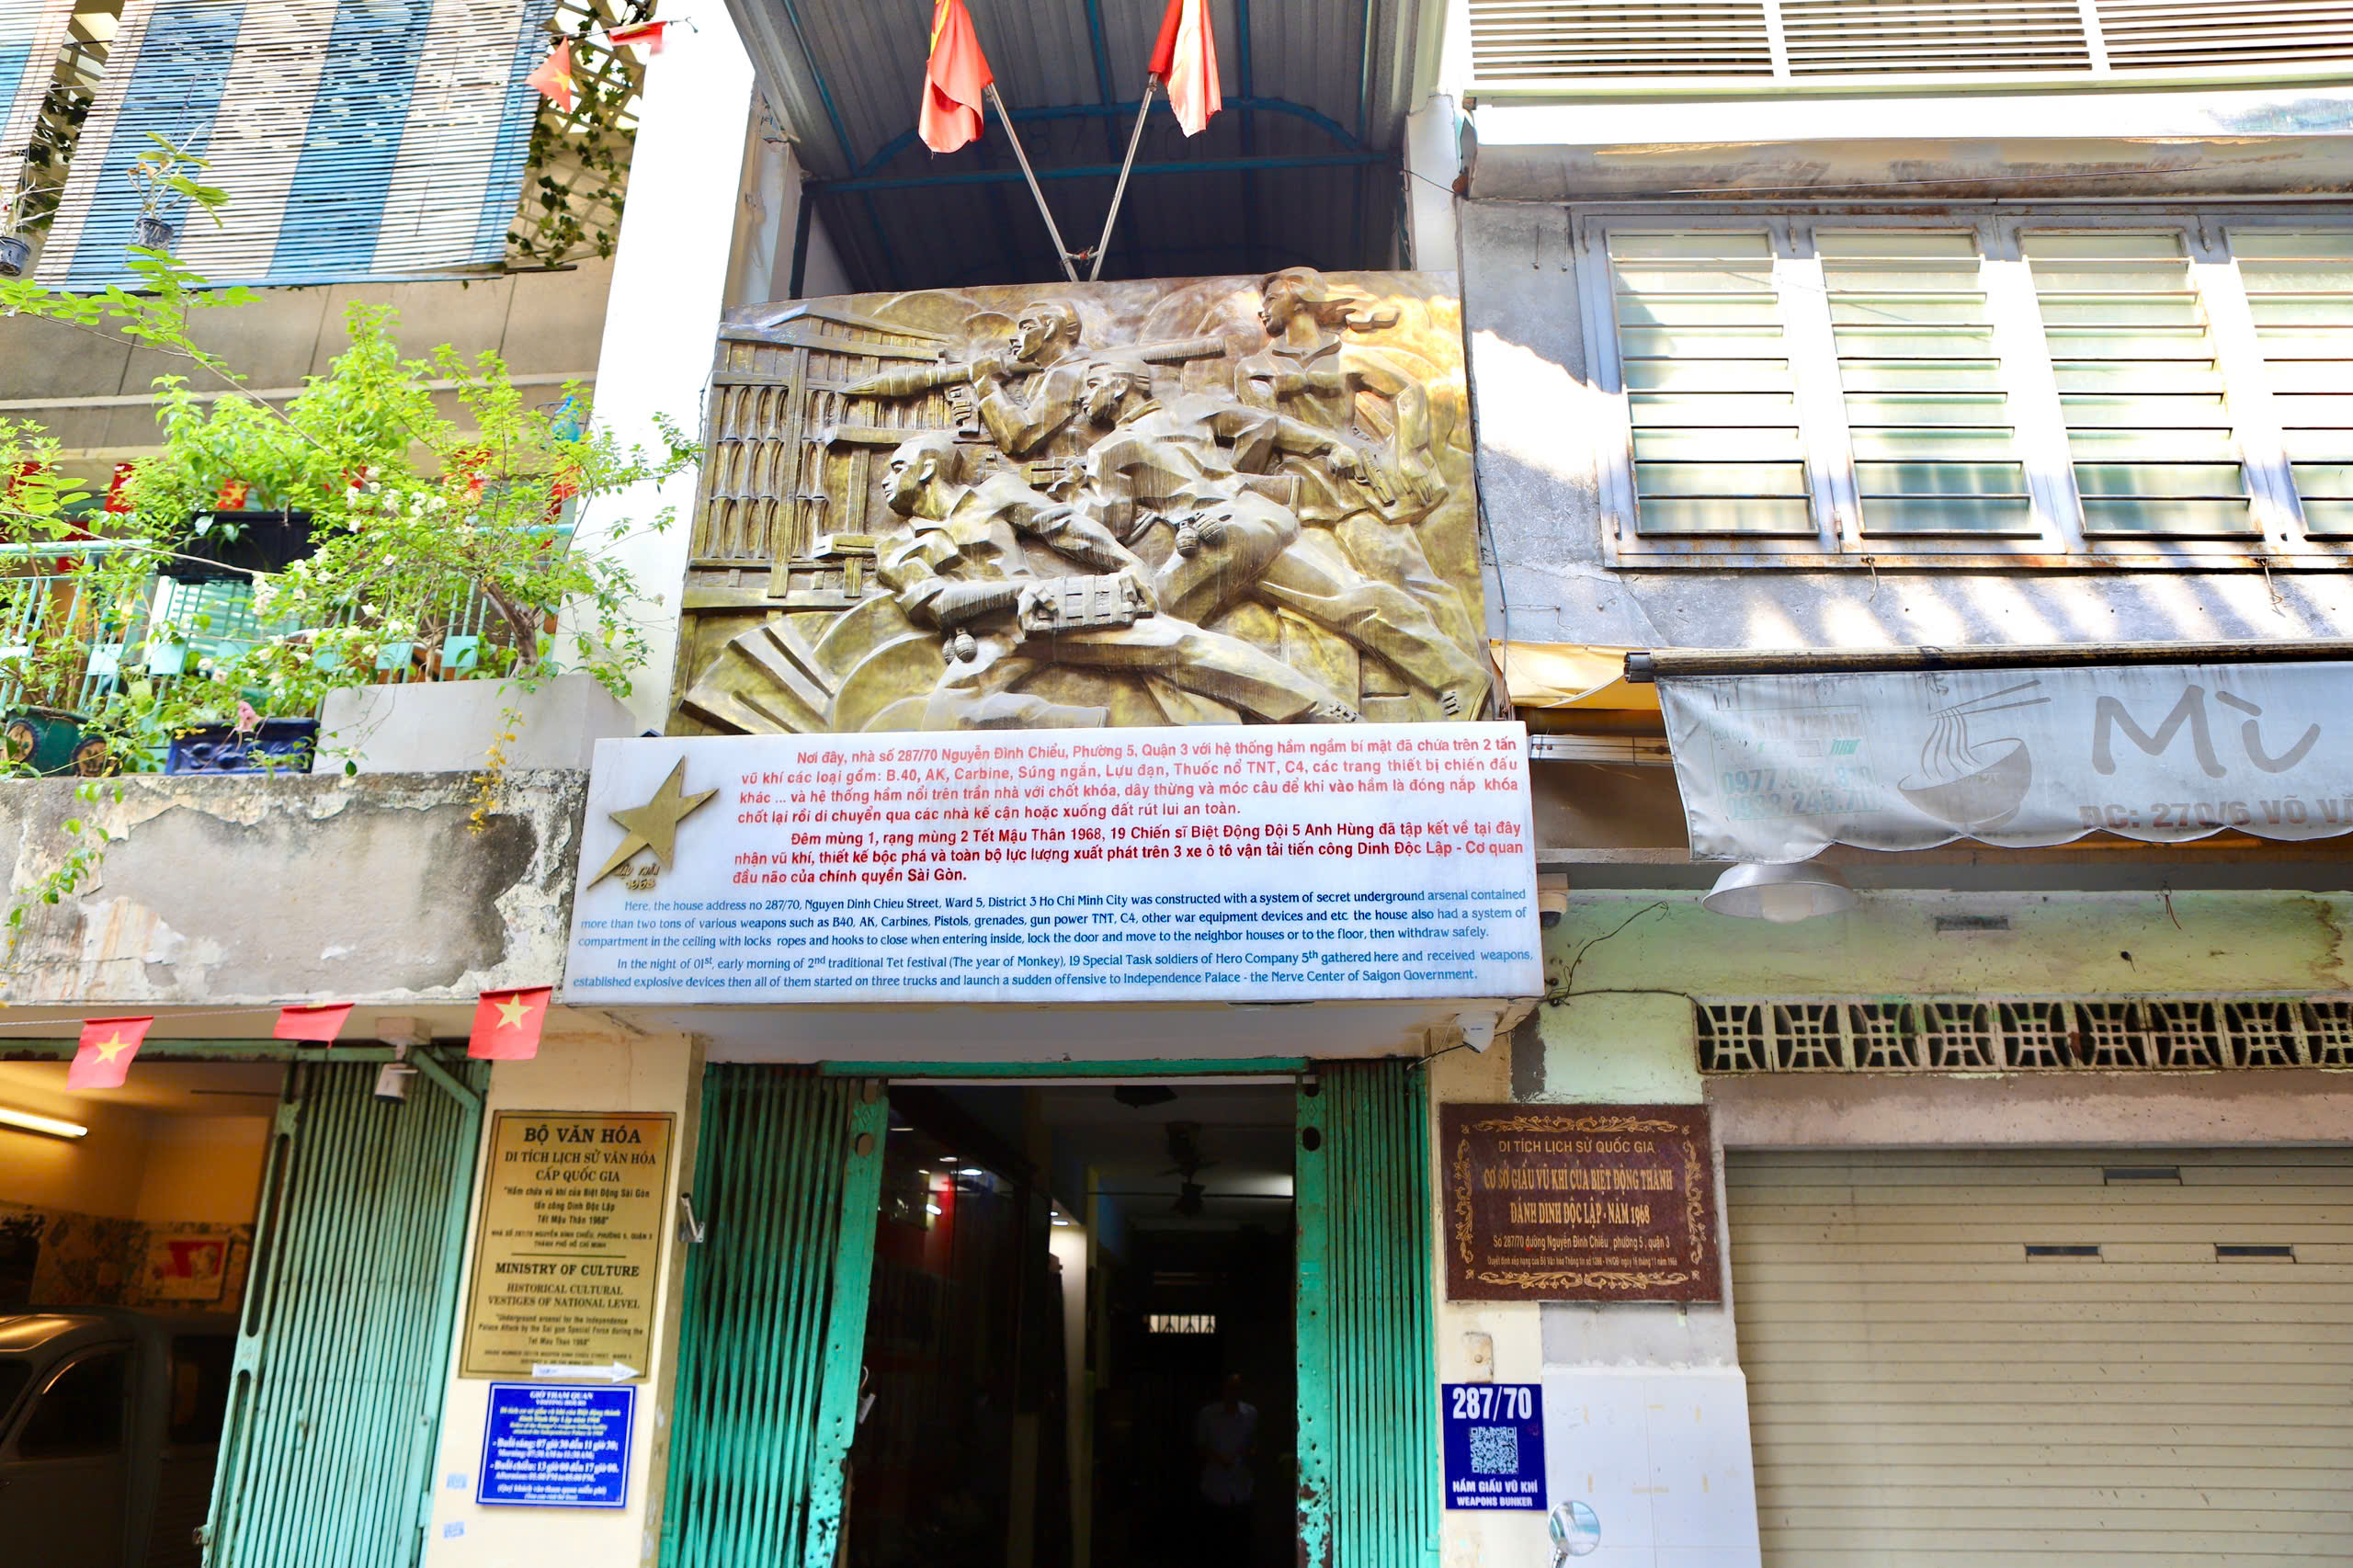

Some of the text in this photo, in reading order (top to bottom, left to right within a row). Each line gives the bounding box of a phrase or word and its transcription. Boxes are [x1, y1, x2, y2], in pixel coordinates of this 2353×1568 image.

[2092, 685, 2321, 778] Mì
[737, 801, 1240, 825] chốt lại rồi di chuyển qua các nhà kế cận hoặc xuống đất rút lui an toàn.
[2151, 801, 2251, 828] 270/6
[2260, 794, 2307, 824] VÕ
[790, 819, 1521, 848] Đêm mùng 1, rạng mùng 2 Tết Mậu Thân 1968, 19 Chiến sĩ Biệt Động Đội 5 Anh Hùng đã tập kết về tại đây
[624, 889, 1526, 912] Here, the house address no 287/70, Nguyen Dinh Chieu Street, Ward 5, District 3 Ho Chi Minh City was constructed with a system of secret underground arsenal contained
[524, 1124, 642, 1146] BỘ VĂN HÓA
[1498, 1136, 1654, 1154] DI TÍCH LỊCH SỬ QUỐC GIA
[505, 1148, 656, 1167] DI TÍCH LỊCH SỬ VĂN HÓA
[535, 1165, 620, 1184] CẤP QUỐC GIA
[1483, 1159, 1673, 1196] CƠ SỞ GIẤU VŨ KHÍ CỦA BIỆT ĐỘNG THÀNH
[1510, 1196, 1537, 1223] ĐÁNH
[1539, 1199, 1562, 1224] DINH
[1563, 1197, 1583, 1229] ĐỘC
[1584, 1197, 1602, 1229] LẬP
[1608, 1197, 1629, 1224] NĂM
[1631, 1202, 1650, 1227] 1968
[1504, 1235, 1524, 1248] 287/70
[1665, 1235, 1670, 1248] 3
[494, 1262, 640, 1277] MINISTRY OF CULTURE
[506, 1282, 623, 1296] HISTORICAL CULTURAL
[488, 1295, 640, 1309] VESTIGES OF NATIONAL LEVEL
[1452, 1386, 1532, 1422] 287/70
[1456, 1495, 1532, 1506] WEAPONS BUNKER
